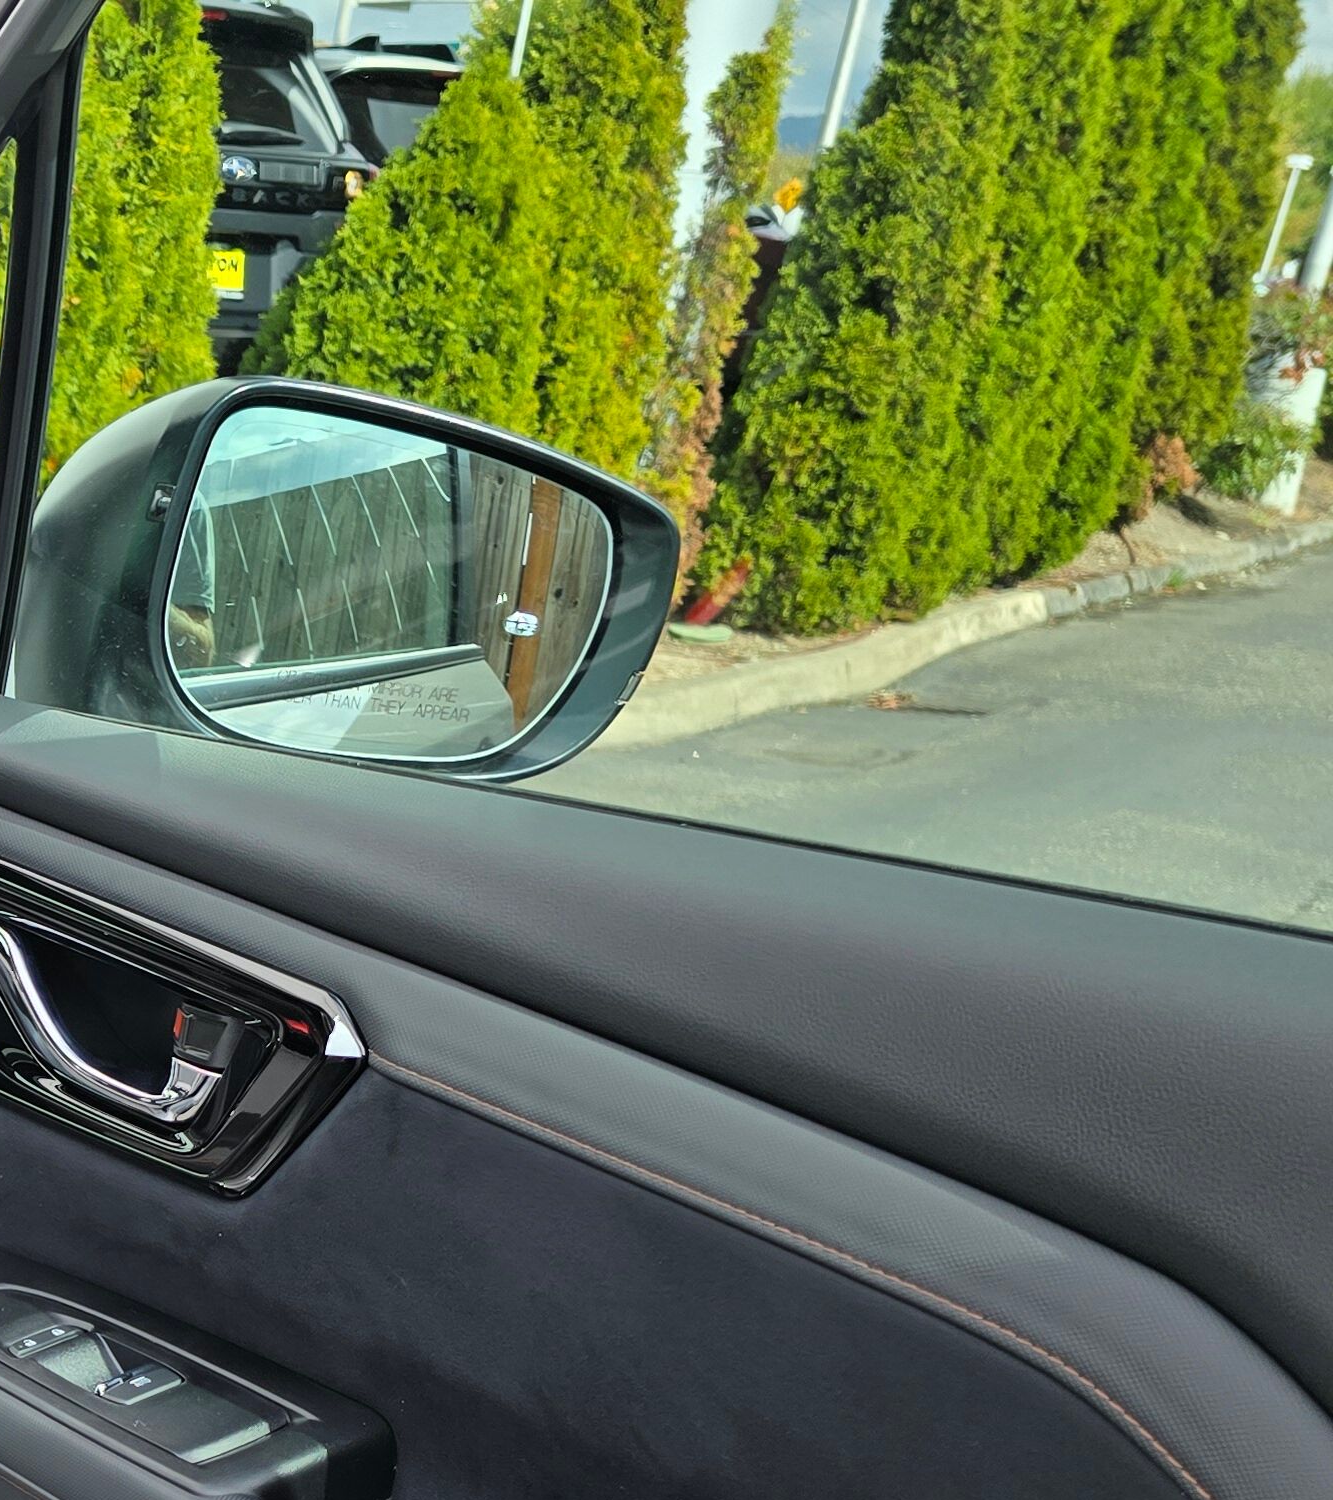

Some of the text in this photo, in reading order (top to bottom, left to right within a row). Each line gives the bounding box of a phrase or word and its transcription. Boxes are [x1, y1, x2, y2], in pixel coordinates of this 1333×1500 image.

[367, 682, 460, 703] MIRROR ARE
[325, 691, 362, 710] THAN
[371, 697, 407, 715] THEY
[413, 703, 470, 723] APPEAR
